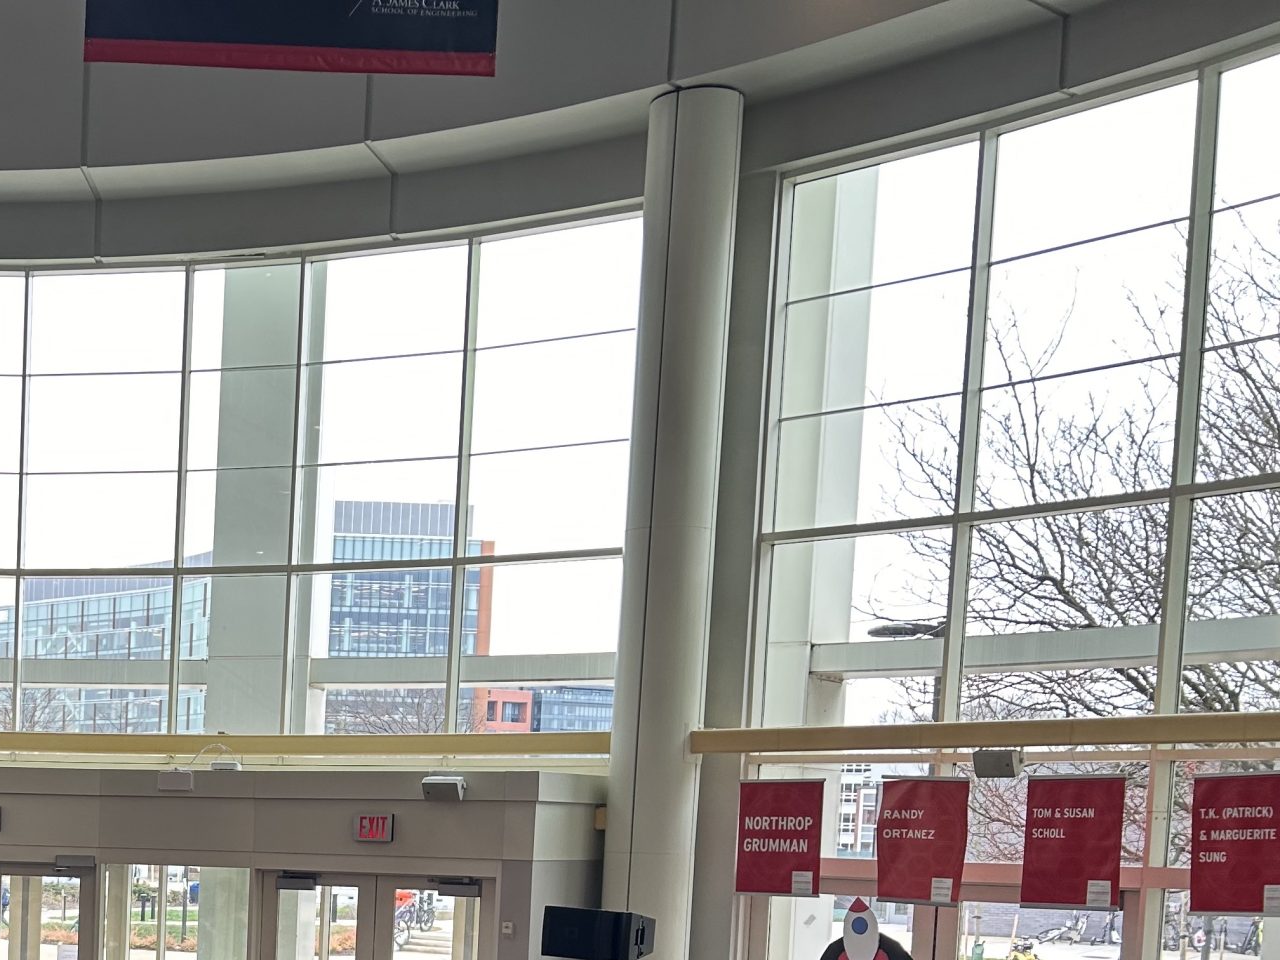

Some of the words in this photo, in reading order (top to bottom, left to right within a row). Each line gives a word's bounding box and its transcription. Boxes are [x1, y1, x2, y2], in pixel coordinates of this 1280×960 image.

[371, 6, 404, 15] SCHOOL
[420, 9, 478, 17] ENGINEERING
[883, 809, 924, 820] RANDY
[1032, 807, 1052, 818] TOM
[1054, 808, 1061, 818] &
[1063, 807, 1095, 819] SUSAN
[1199, 808, 1219, 820] T.K.
[1222, 806, 1274, 819] (PATRICK)
[359, 815, 388, 839] EXIT
[744, 816, 813, 831] NORTHROP
[883, 829, 936, 840] ORTANEZ
[1032, 828, 1066, 839] SCHOLL
[1199, 830, 1207, 841] &
[1211, 828, 1277, 841] MARGUERITE
[743, 838, 808, 853] GRUMMAN
[1199, 851, 1227, 863] SUNG
